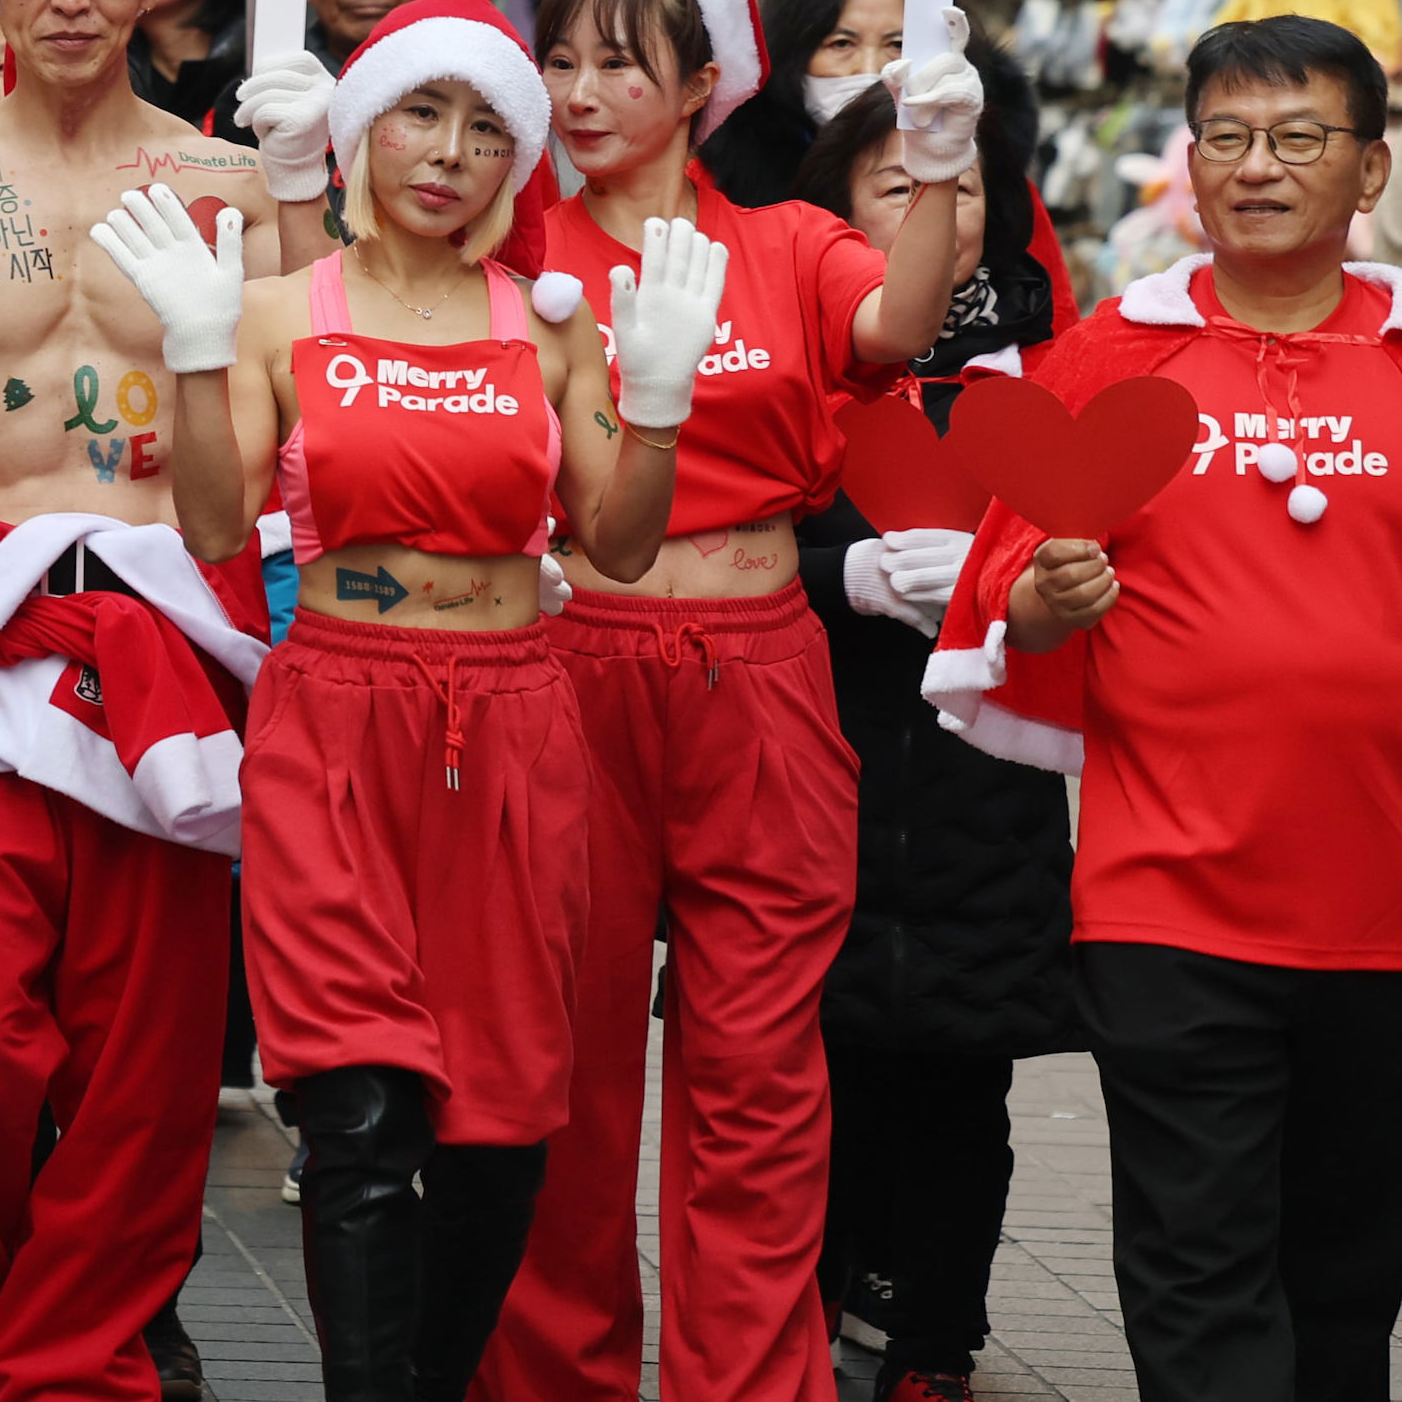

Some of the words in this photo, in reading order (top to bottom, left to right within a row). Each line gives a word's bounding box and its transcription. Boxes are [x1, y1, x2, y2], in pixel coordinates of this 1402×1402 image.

[177, 150, 227, 168] Donate
[229, 152, 257, 168] Life
[9, 247, 55, 284] 시작
[376, 358, 488, 391] Merry
[377, 383, 520, 416] Parade
[1234, 438, 1389, 477] Pade
[729, 547, 778, 571] love
